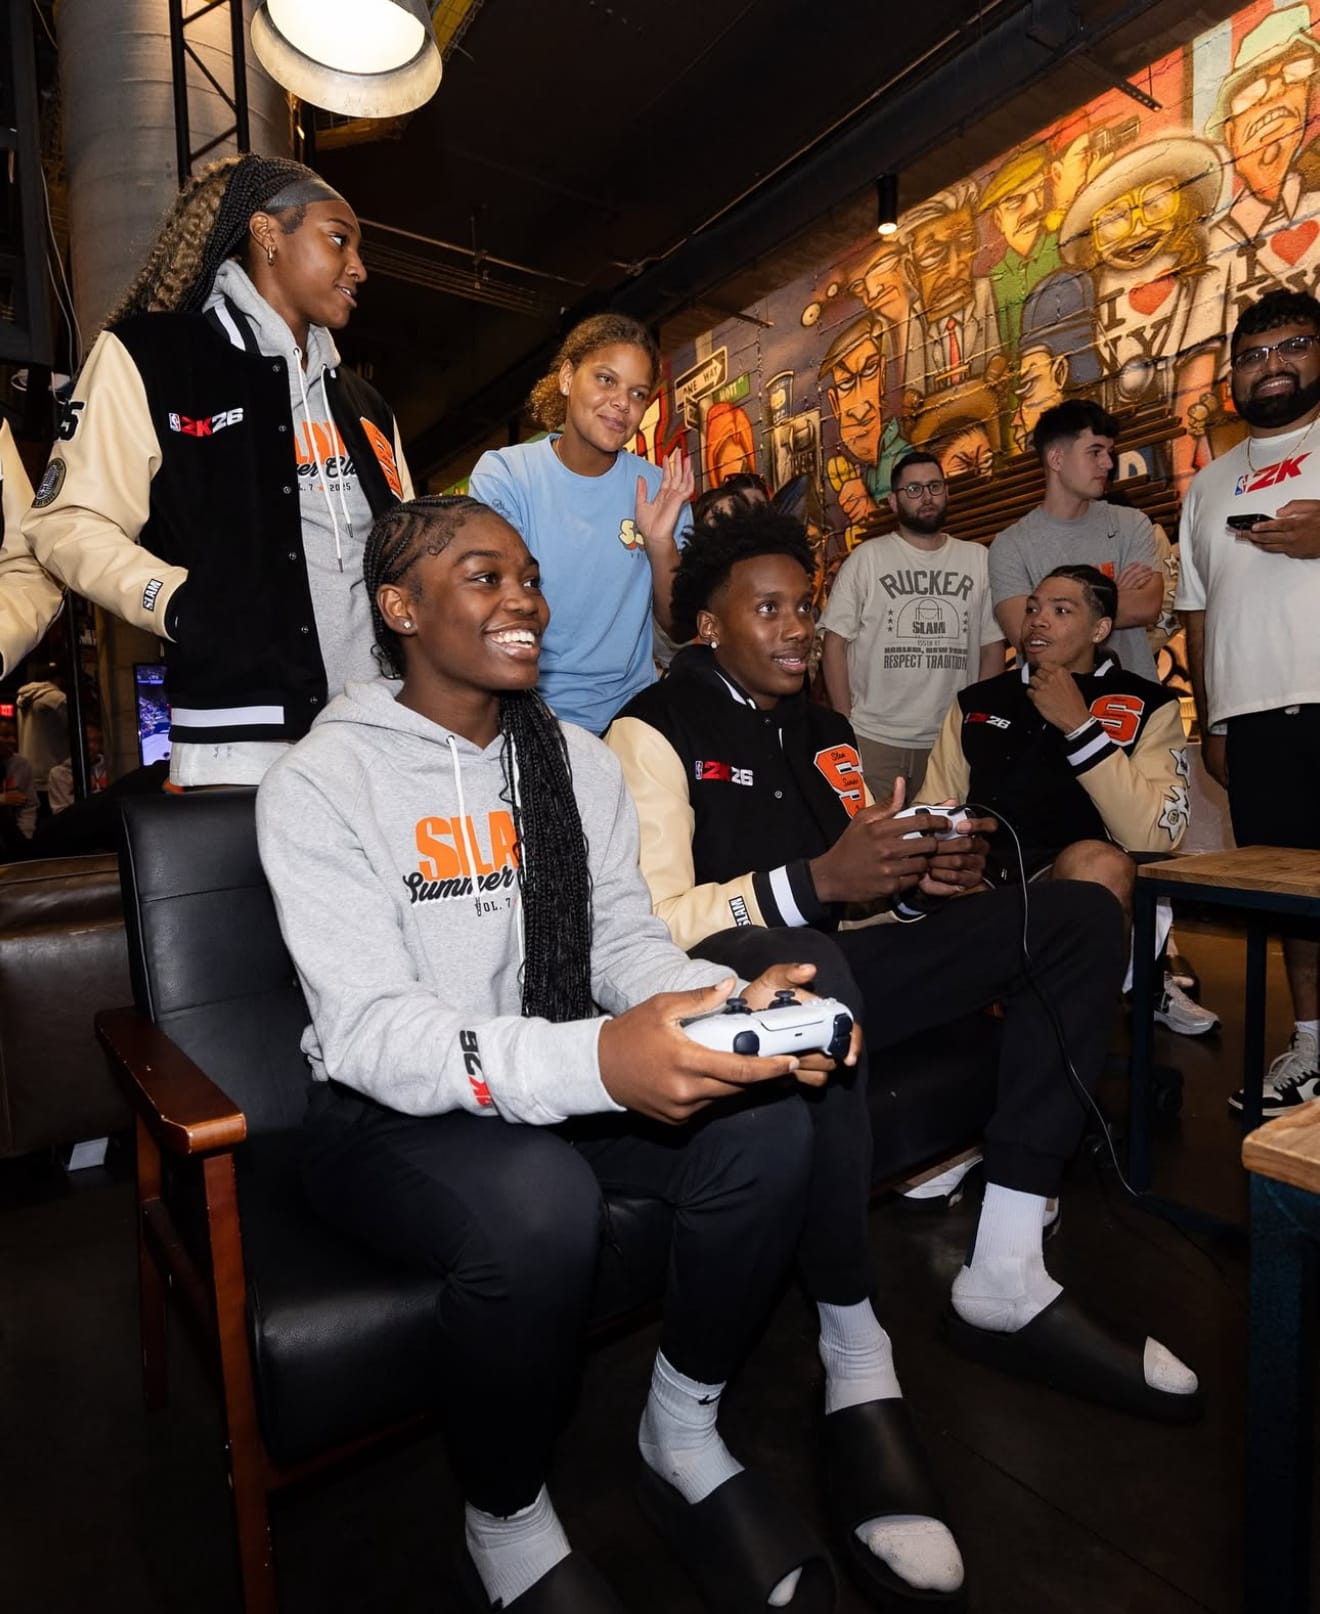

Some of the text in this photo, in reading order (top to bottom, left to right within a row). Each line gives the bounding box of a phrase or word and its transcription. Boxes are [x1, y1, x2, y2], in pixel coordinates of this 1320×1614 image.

[703, 365, 719, 382] WAY
[181, 407, 244, 438] 2K26
[1246, 451, 1313, 493] 2K
[143, 579, 162, 610] SLAM
[879, 569, 975, 601] RUCKER
[911, 620, 947, 635] SLAM
[883, 654, 968, 670] RESPECT TRADITION
[702, 760, 754, 787] 2K26
[414, 810, 520, 881] SLA
[402, 865, 515, 905] Summer
[505, 898, 512, 909] 7
